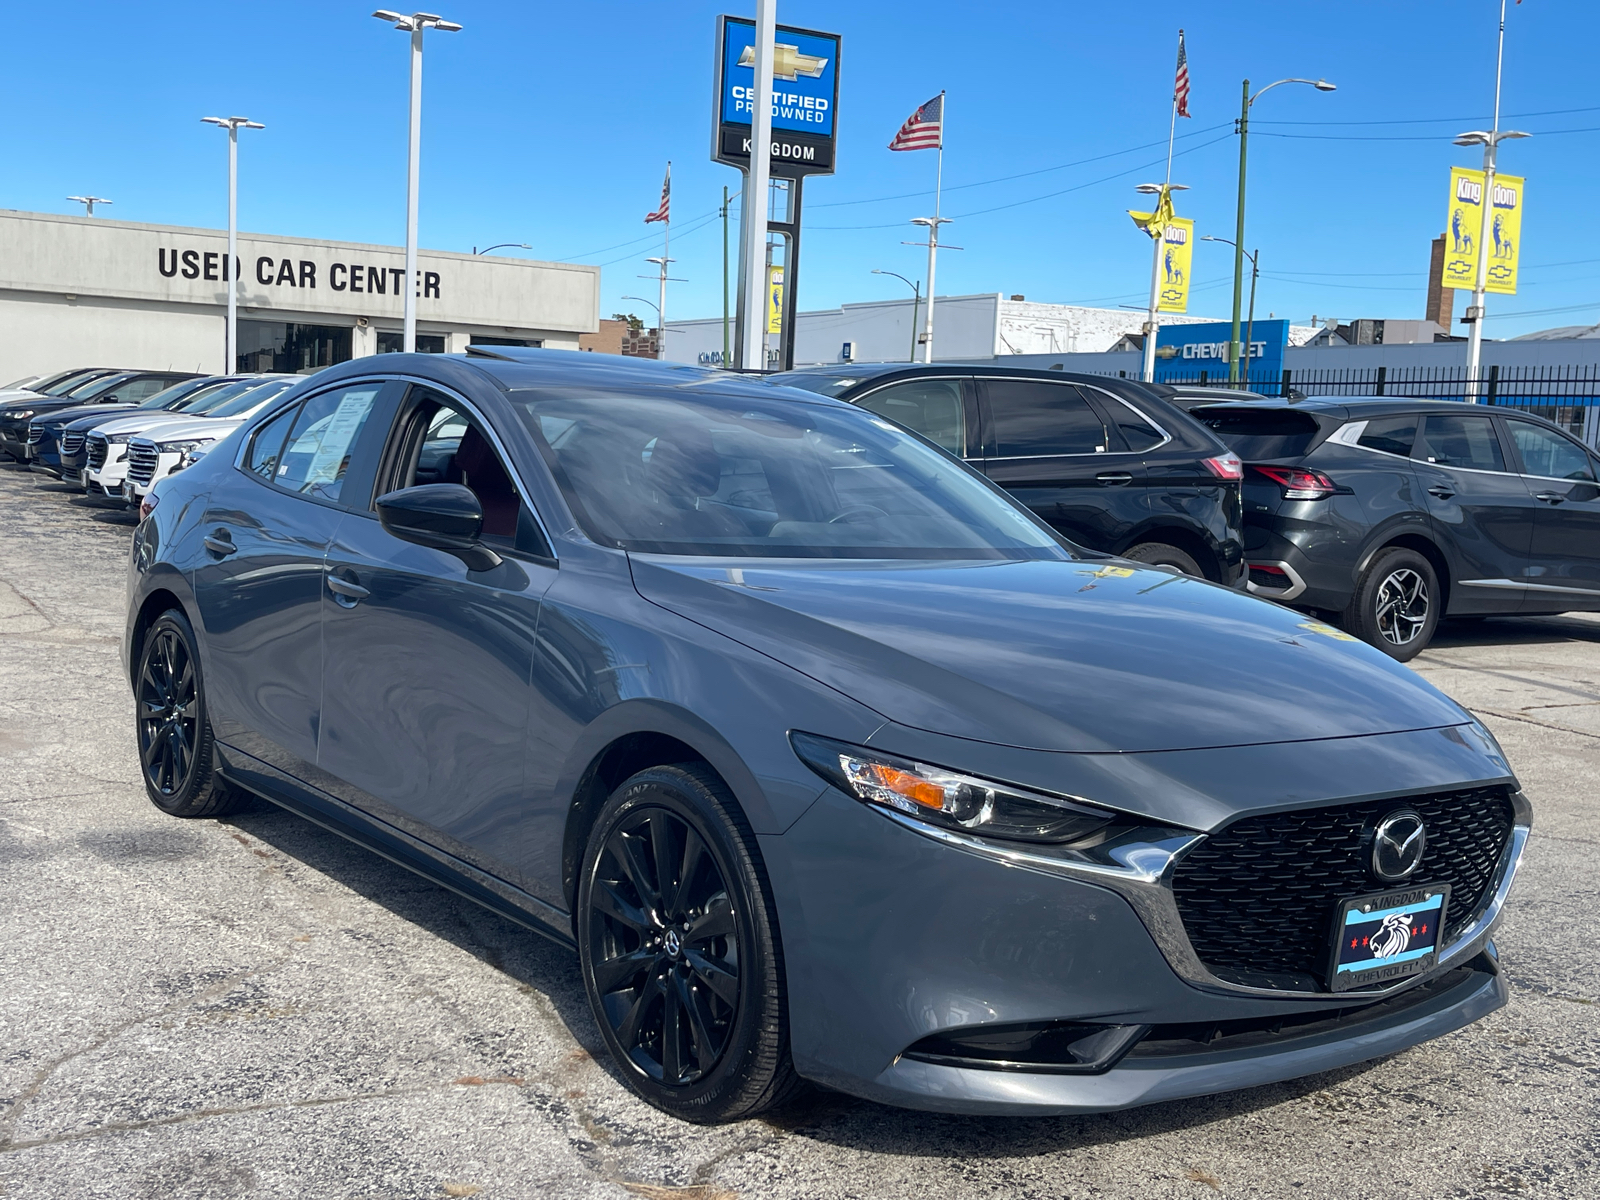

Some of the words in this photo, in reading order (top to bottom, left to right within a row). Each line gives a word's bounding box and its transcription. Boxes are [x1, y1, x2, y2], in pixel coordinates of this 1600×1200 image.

[732, 86, 829, 111] CETIFIED
[735, 101, 824, 123] PROWNED
[743, 138, 815, 160] KGDOM
[1457, 177, 1482, 205] King
[1493, 183, 1516, 208] dom
[1165, 224, 1187, 244] dom
[158, 248, 241, 282] USED
[256, 256, 316, 289] CAR
[772, 271, 784, 284] do
[1182, 341, 1267, 359] CHEVRLET
[1370, 890, 1427, 909] KINGDOM
